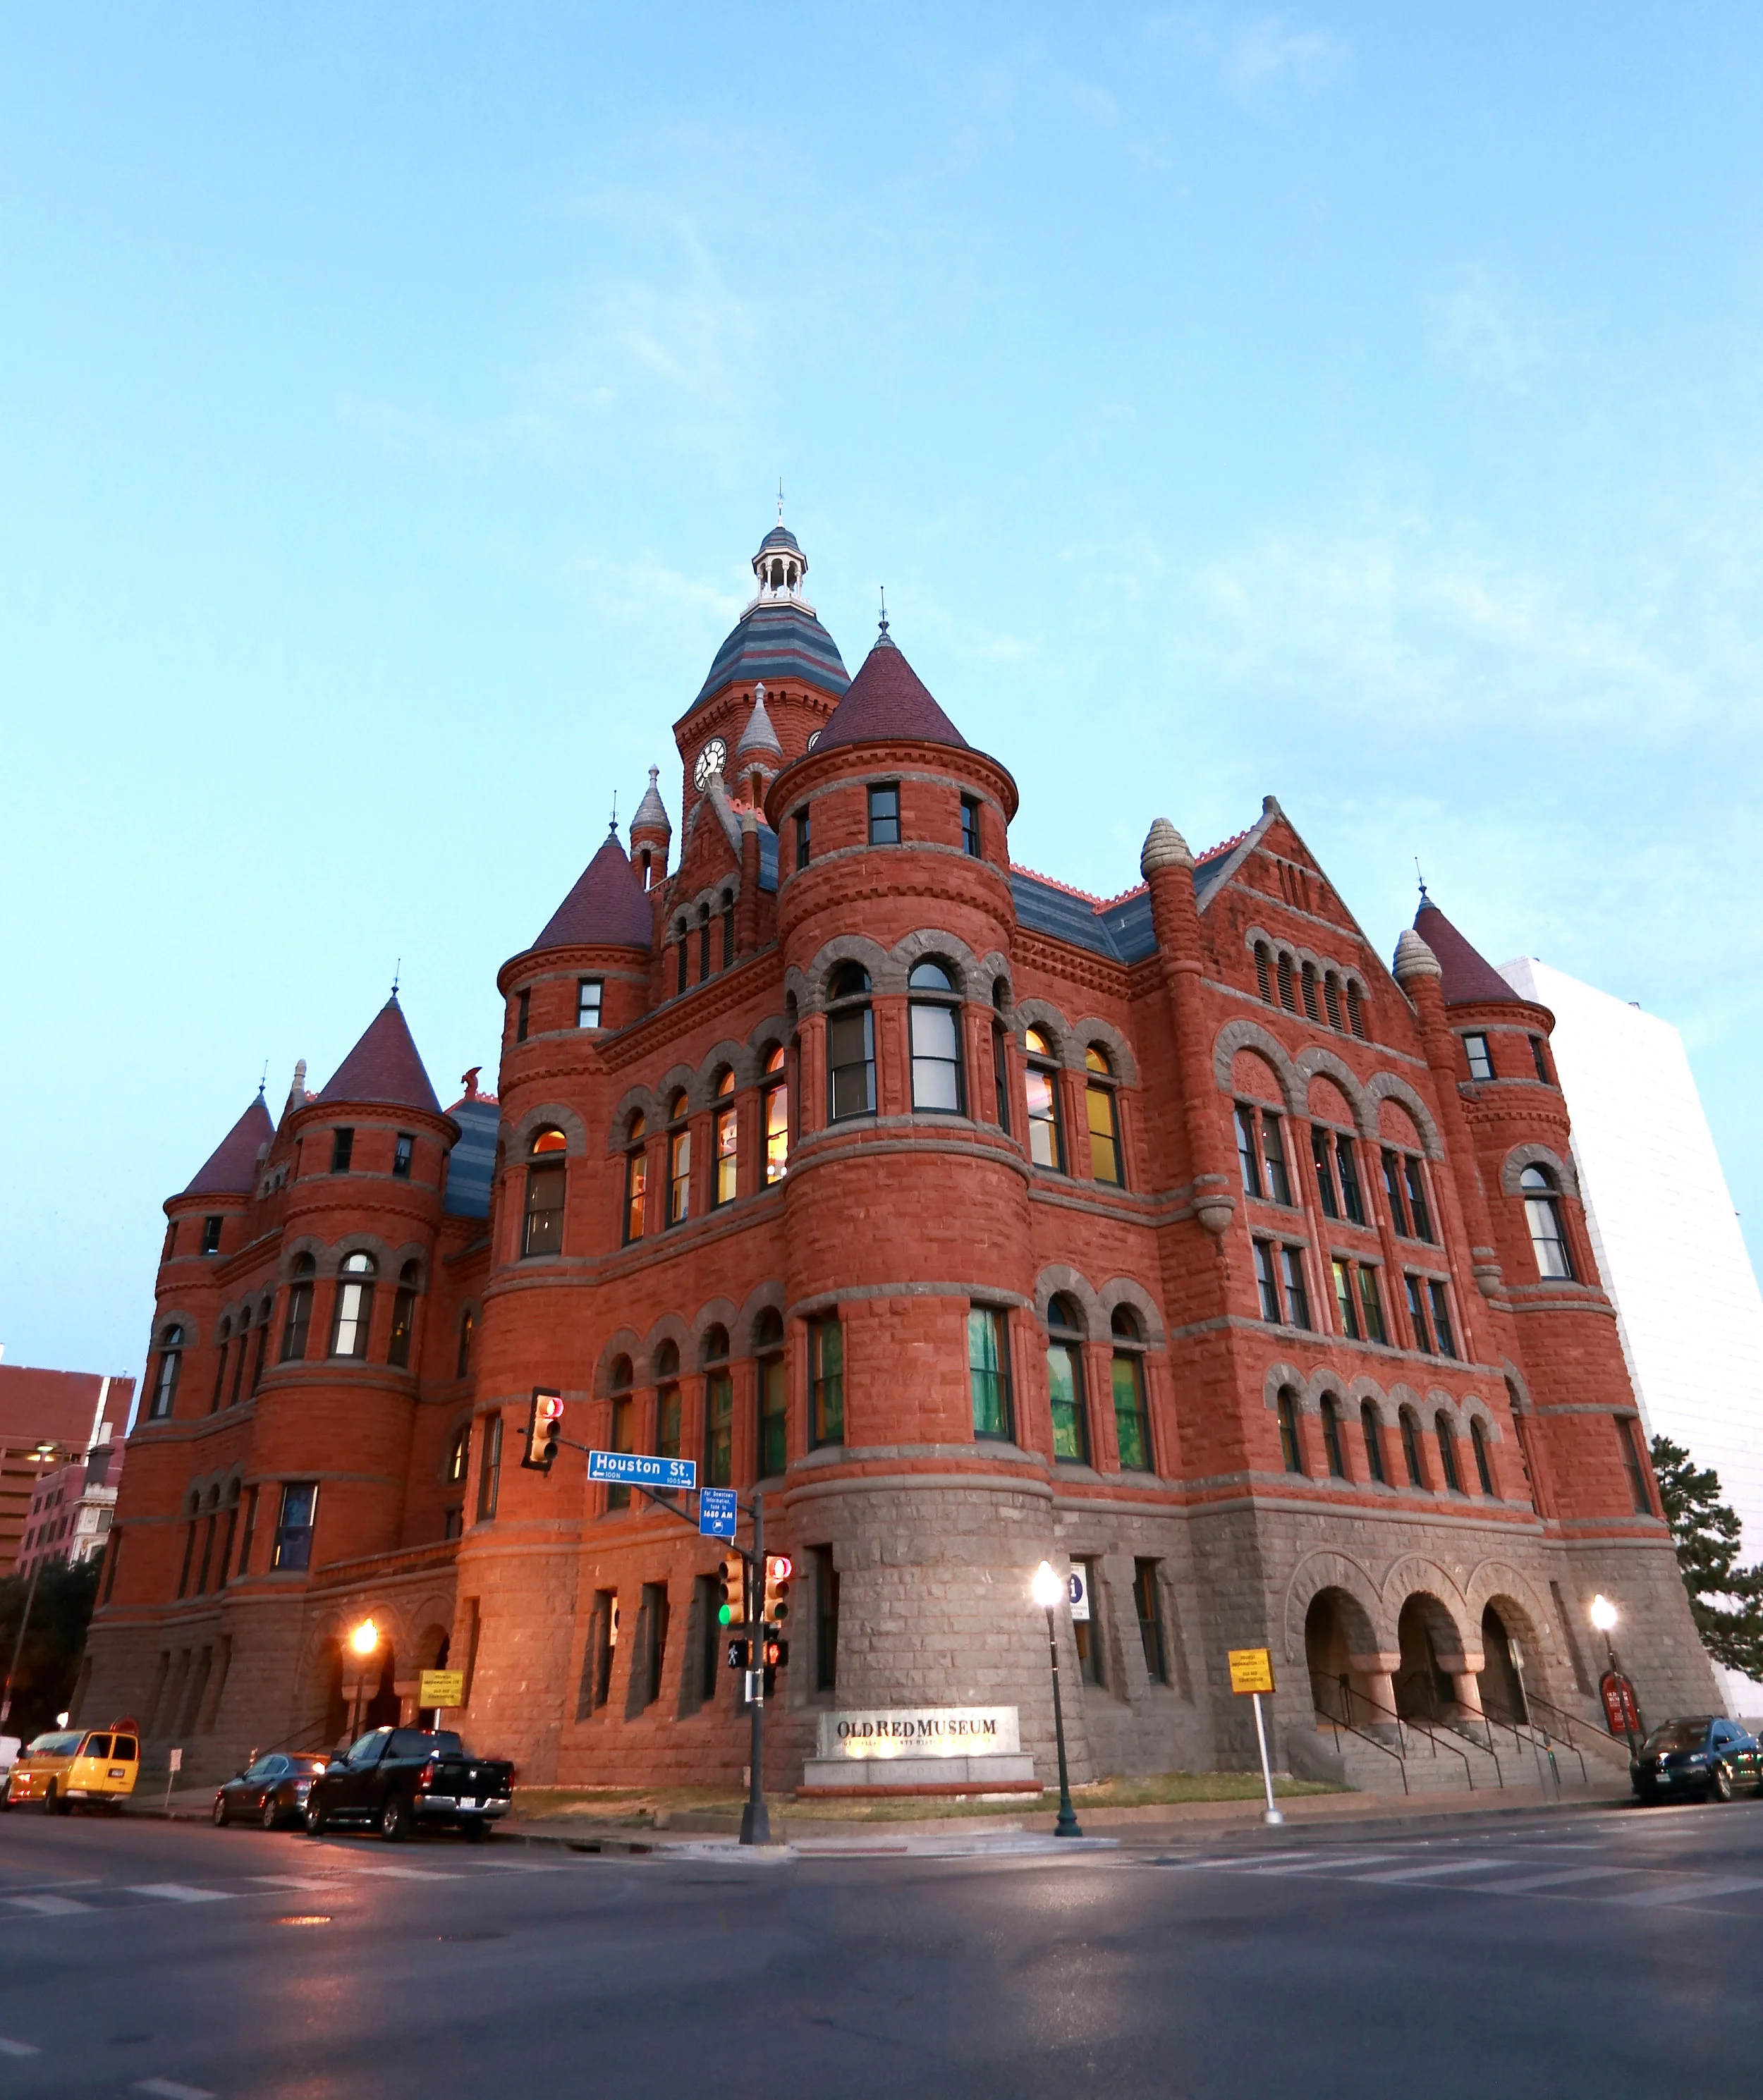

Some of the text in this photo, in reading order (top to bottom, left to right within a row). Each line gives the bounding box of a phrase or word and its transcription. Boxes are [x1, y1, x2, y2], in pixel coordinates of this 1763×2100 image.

[597, 1454, 689, 1477] Houston St.
[837, 1719, 996, 1738] OLD RED MUSEUM
